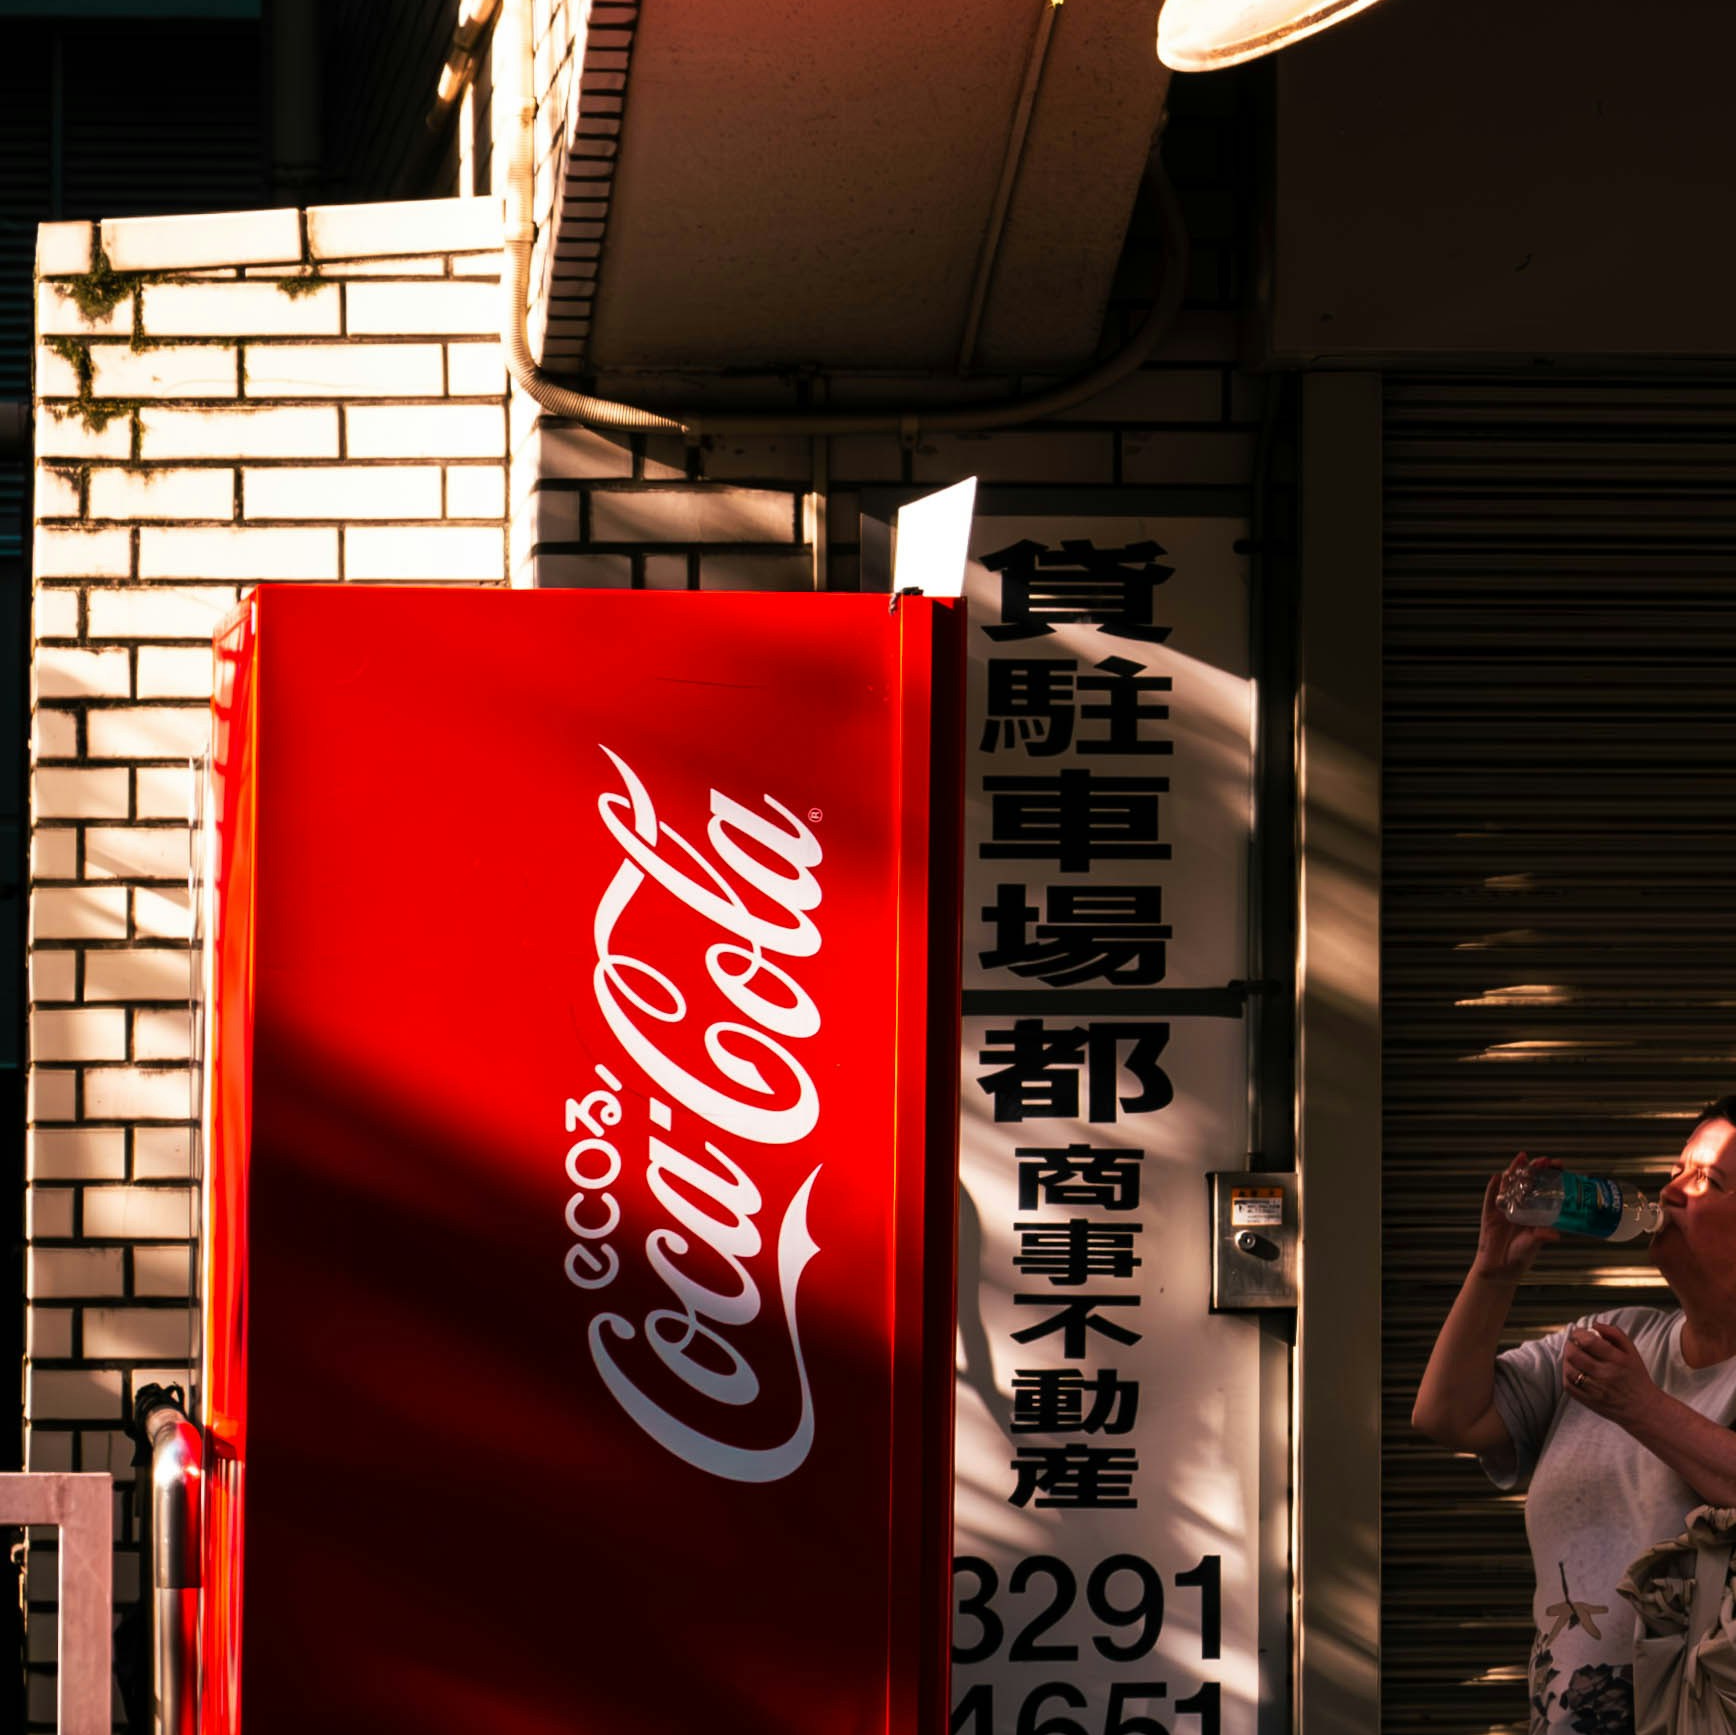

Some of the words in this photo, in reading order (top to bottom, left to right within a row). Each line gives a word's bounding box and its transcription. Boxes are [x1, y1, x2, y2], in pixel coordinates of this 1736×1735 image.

[979, 538, 1175, 987] 貸駐車場
[588, 744, 823, 1482] Coca-Cola
[951, 1553, 1221, 1665] 3291
